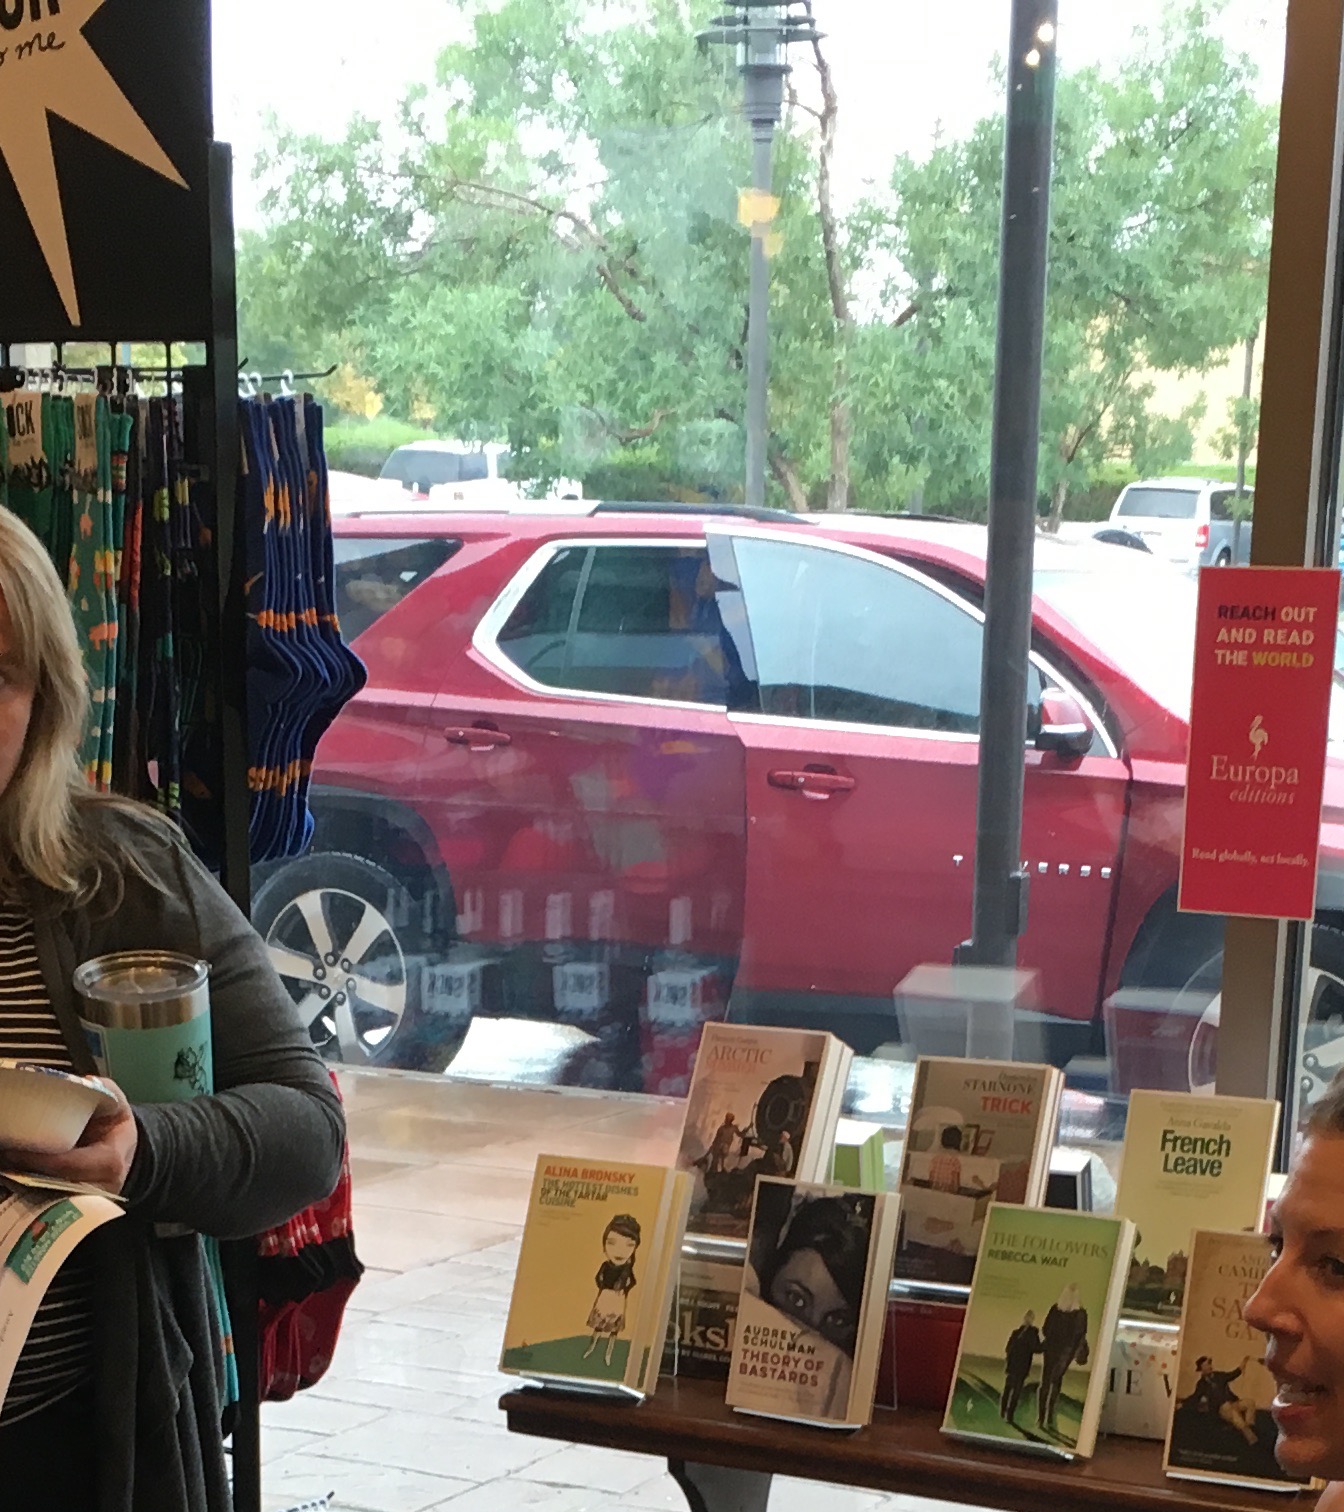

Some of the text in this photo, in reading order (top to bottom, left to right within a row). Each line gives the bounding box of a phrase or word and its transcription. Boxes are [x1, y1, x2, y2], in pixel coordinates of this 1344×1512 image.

[15, 31, 66, 60] me
[6, 400, 35, 439] OCK
[1218, 605, 1317, 622] REACH OUT
[1216, 627, 1314, 645] AND READ
[1215, 649, 1314, 667] THE WORLD
[1210, 754, 1299, 789] Europa
[1229, 784, 1294, 805] editions
[707, 1045, 772, 1065] ARCTIC
[981, 1096, 1033, 1115] TRICK
[1160, 1129, 1232, 1158] French
[544, 1166, 636, 1184] ALINA BRONSKY
[1162, 1153, 1223, 1178] Leave
[992, 1232, 1109, 1258] THE FOLLOWERS
[987, 1249, 1069, 1268] REBECCA WAIT
[744, 1325, 797, 1341] AUDREY
[743, 1335, 816, 1355] SCHULMAN
[742, 1348, 824, 1372] THEORY OF
[739, 1362, 818, 1387] BASTARDS
